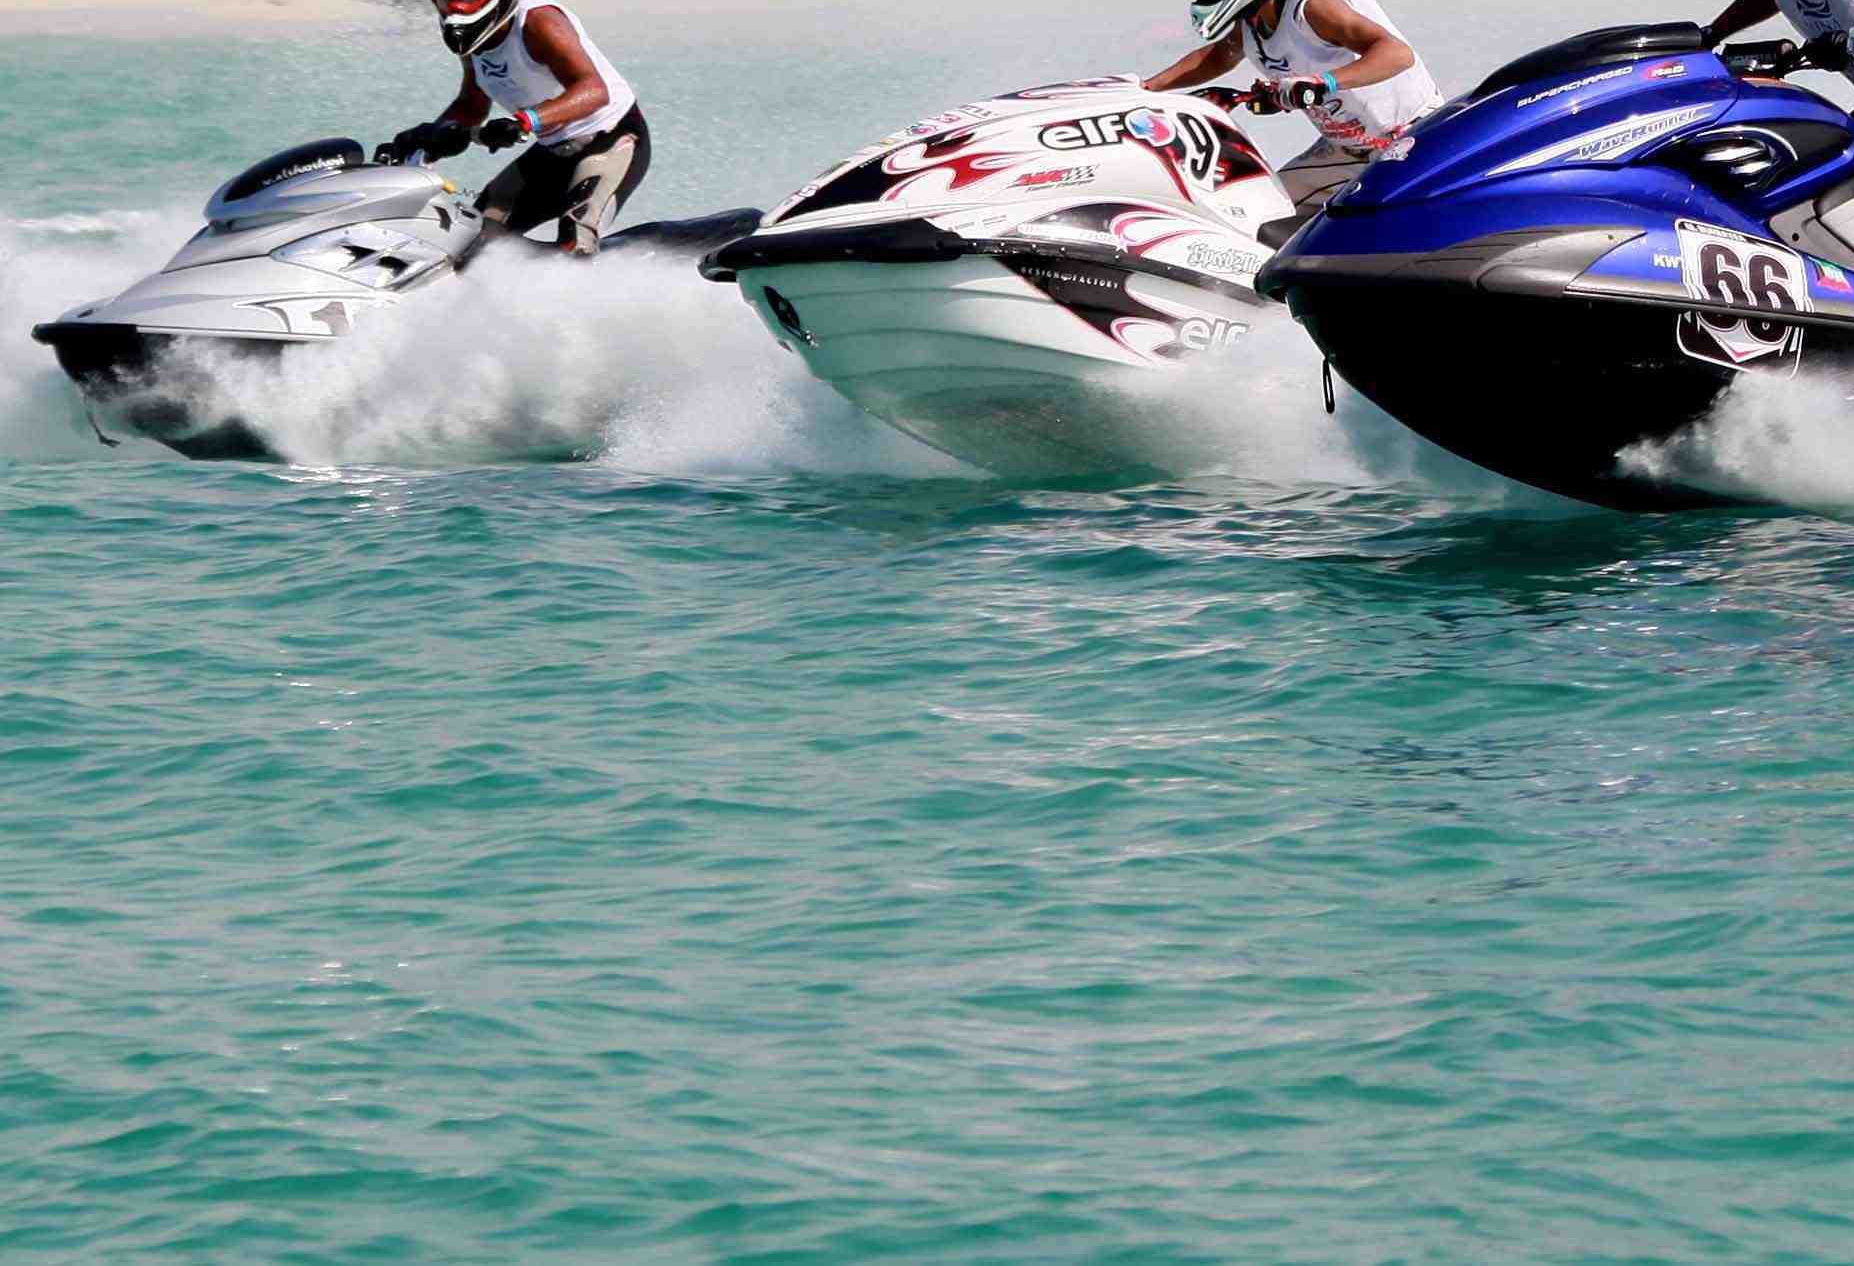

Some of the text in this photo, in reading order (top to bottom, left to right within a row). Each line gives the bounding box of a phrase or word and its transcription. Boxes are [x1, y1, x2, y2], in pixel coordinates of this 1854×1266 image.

[1516, 66, 1633, 108] SUPERCHARGED
[1039, 112, 1125, 150] elf
[1579, 108, 1697, 157] WaveRunner
[1072, 274, 1119, 290] FACTORY
[1699, 243, 1797, 343] 66
